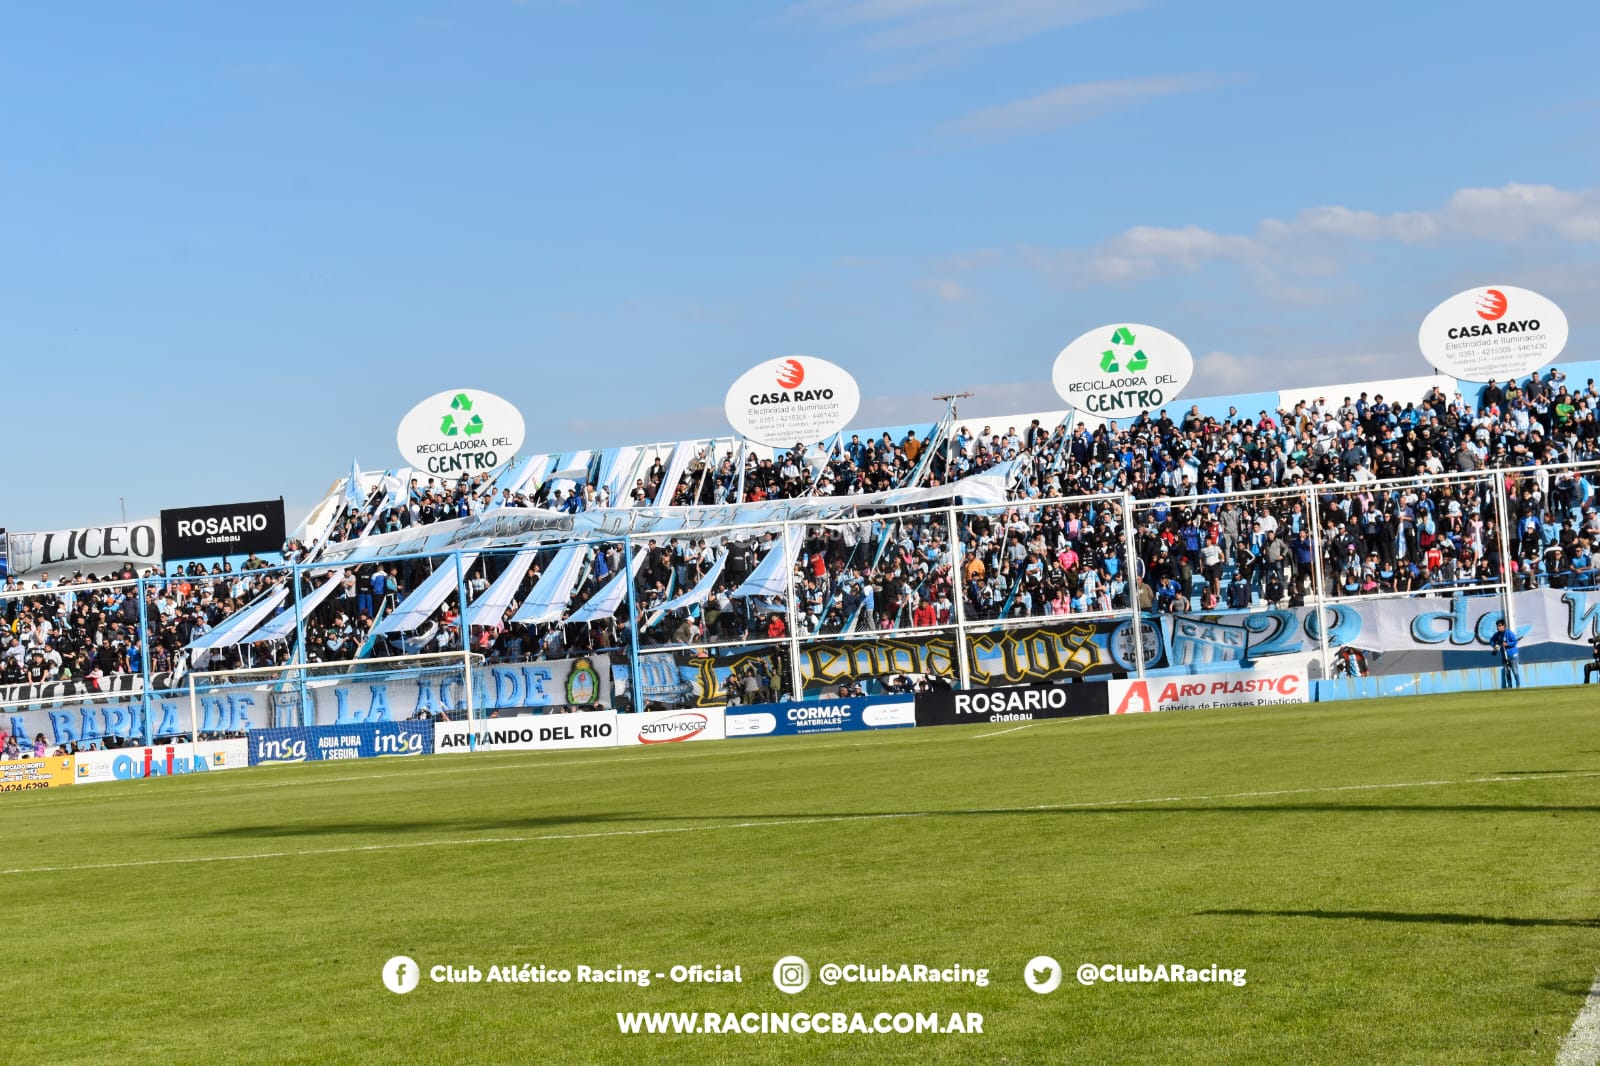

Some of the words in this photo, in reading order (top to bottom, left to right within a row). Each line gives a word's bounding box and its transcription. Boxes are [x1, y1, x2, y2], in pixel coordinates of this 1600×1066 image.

[1448, 324, 1492, 339] CASA
[1496, 319, 1541, 335] RAYO
[1445, 339, 1491, 350] Electricidad
[1501, 334, 1546, 344] Iluminación
[1068, 376, 1148, 392] RECICLADORA
[1155, 374, 1178, 385] DEL
[749, 392, 791, 405] CASA
[794, 388, 834, 402] RAYO
[1086, 388, 1163, 412] CENTRO
[416, 439, 488, 454] RECICLADORA
[492, 437, 513, 447] DEL
[427, 451, 498, 473] CENTRO
[177, 513, 267, 538] ROSARIO
[40, 525, 156, 564] LICEO
[206, 534, 241, 544] chateau
[689, 624, 1102, 707] Lendarios
[1122, 649, 1156, 663] ACDE
[1157, 682, 1206, 703] ARO
[1210, 674, 1300, 694] PLASTYC
[200, 692, 255, 732] DE
[334, 684, 392, 726] LA
[955, 689, 1066, 714] ROSARIO
[1198, 701, 1210, 709] de
[1213, 699, 1255, 709] Envases
[787, 705, 851, 720] CORMAC
[796, 717, 842, 727] MATERIALES
[989, 712, 1033, 723] chateau
[319, 737, 341, 748] AGUA
[341, 735, 361, 746] PURA
[374, 730, 424, 753] insa
[441, 729, 534, 748] ARMANDO
[539, 727, 574, 742] DEL
[580, 723, 612, 738] RIO
[258, 735, 307, 759] insa
[322, 749, 328, 760] Y
[328, 748, 359, 760] SEGURA
